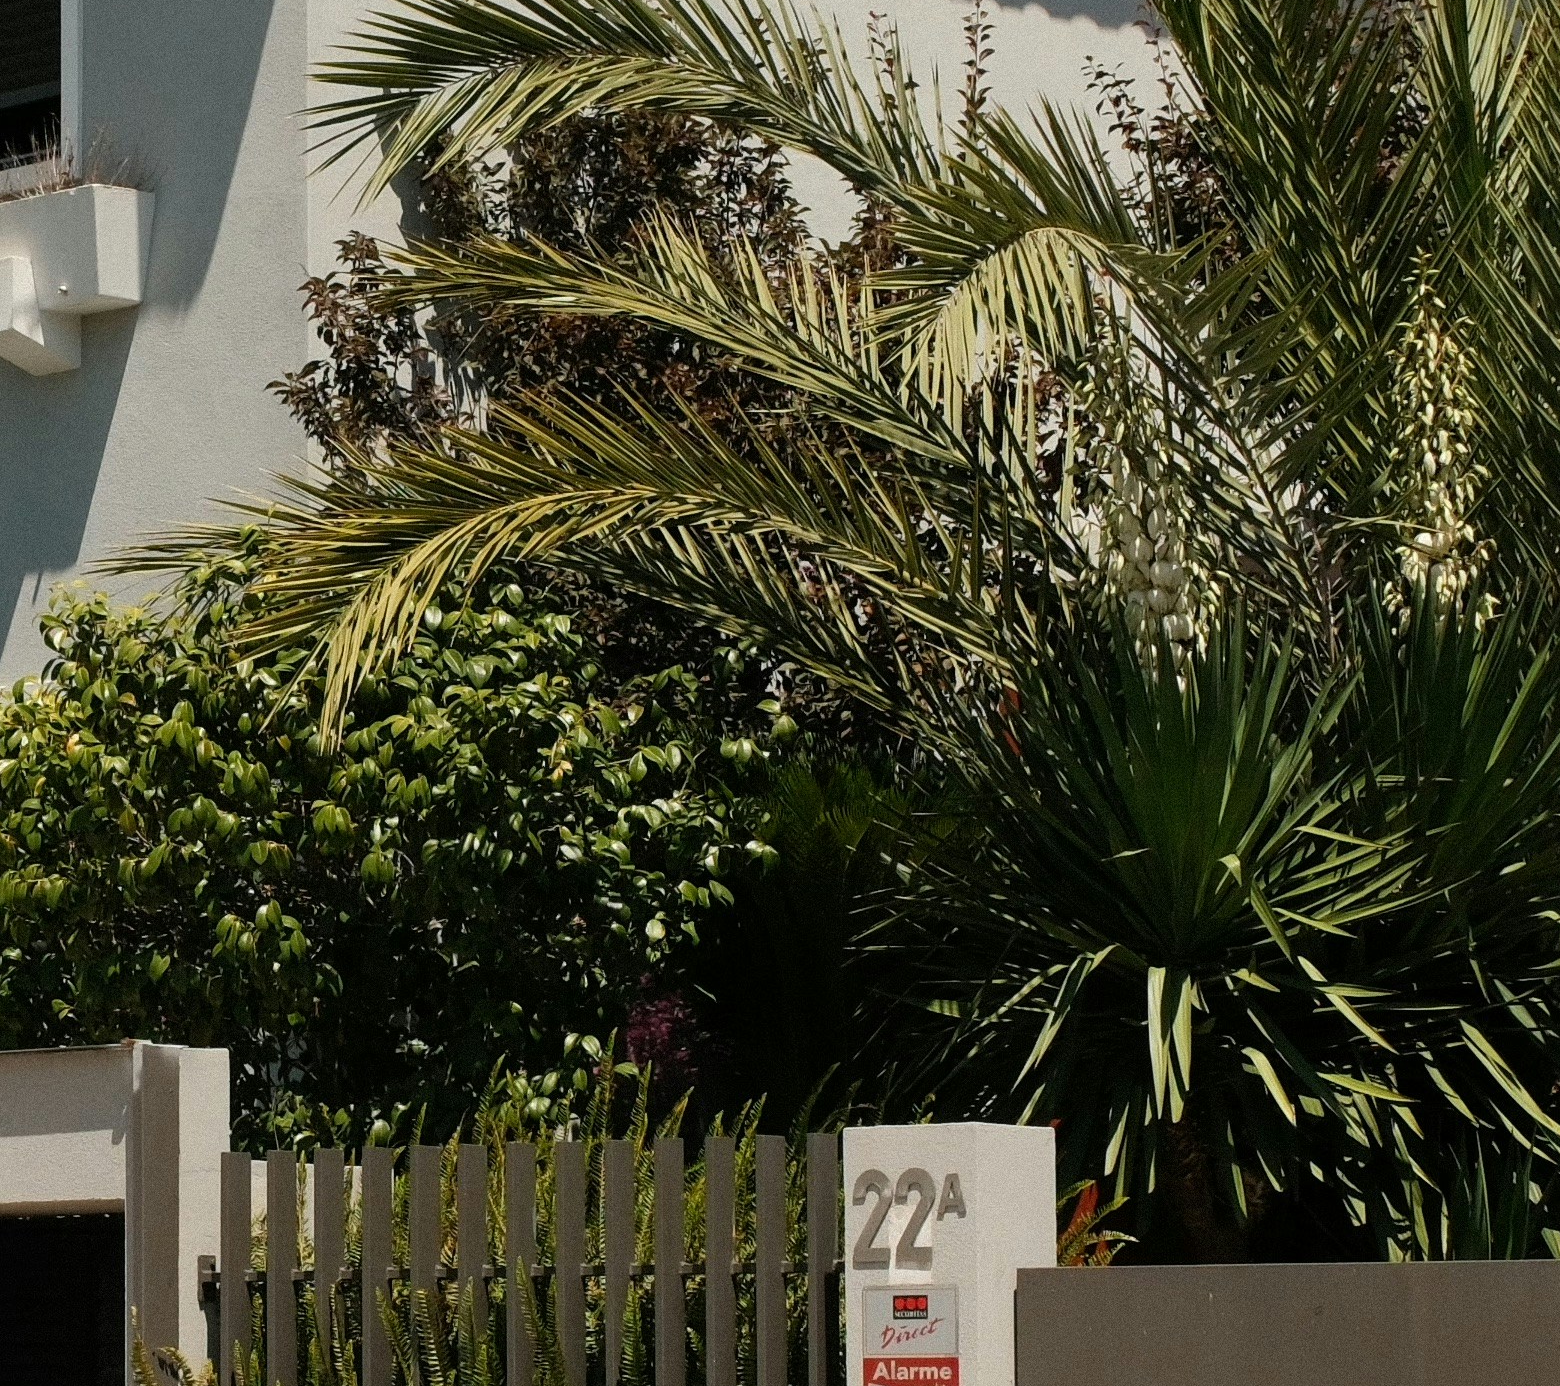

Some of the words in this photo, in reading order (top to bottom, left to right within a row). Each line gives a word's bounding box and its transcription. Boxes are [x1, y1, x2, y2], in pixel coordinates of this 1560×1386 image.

[852, 1167, 967, 1272] 22A
[881, 1318, 943, 1349] Direct
[872, 1360, 952, 1380] Alarme
